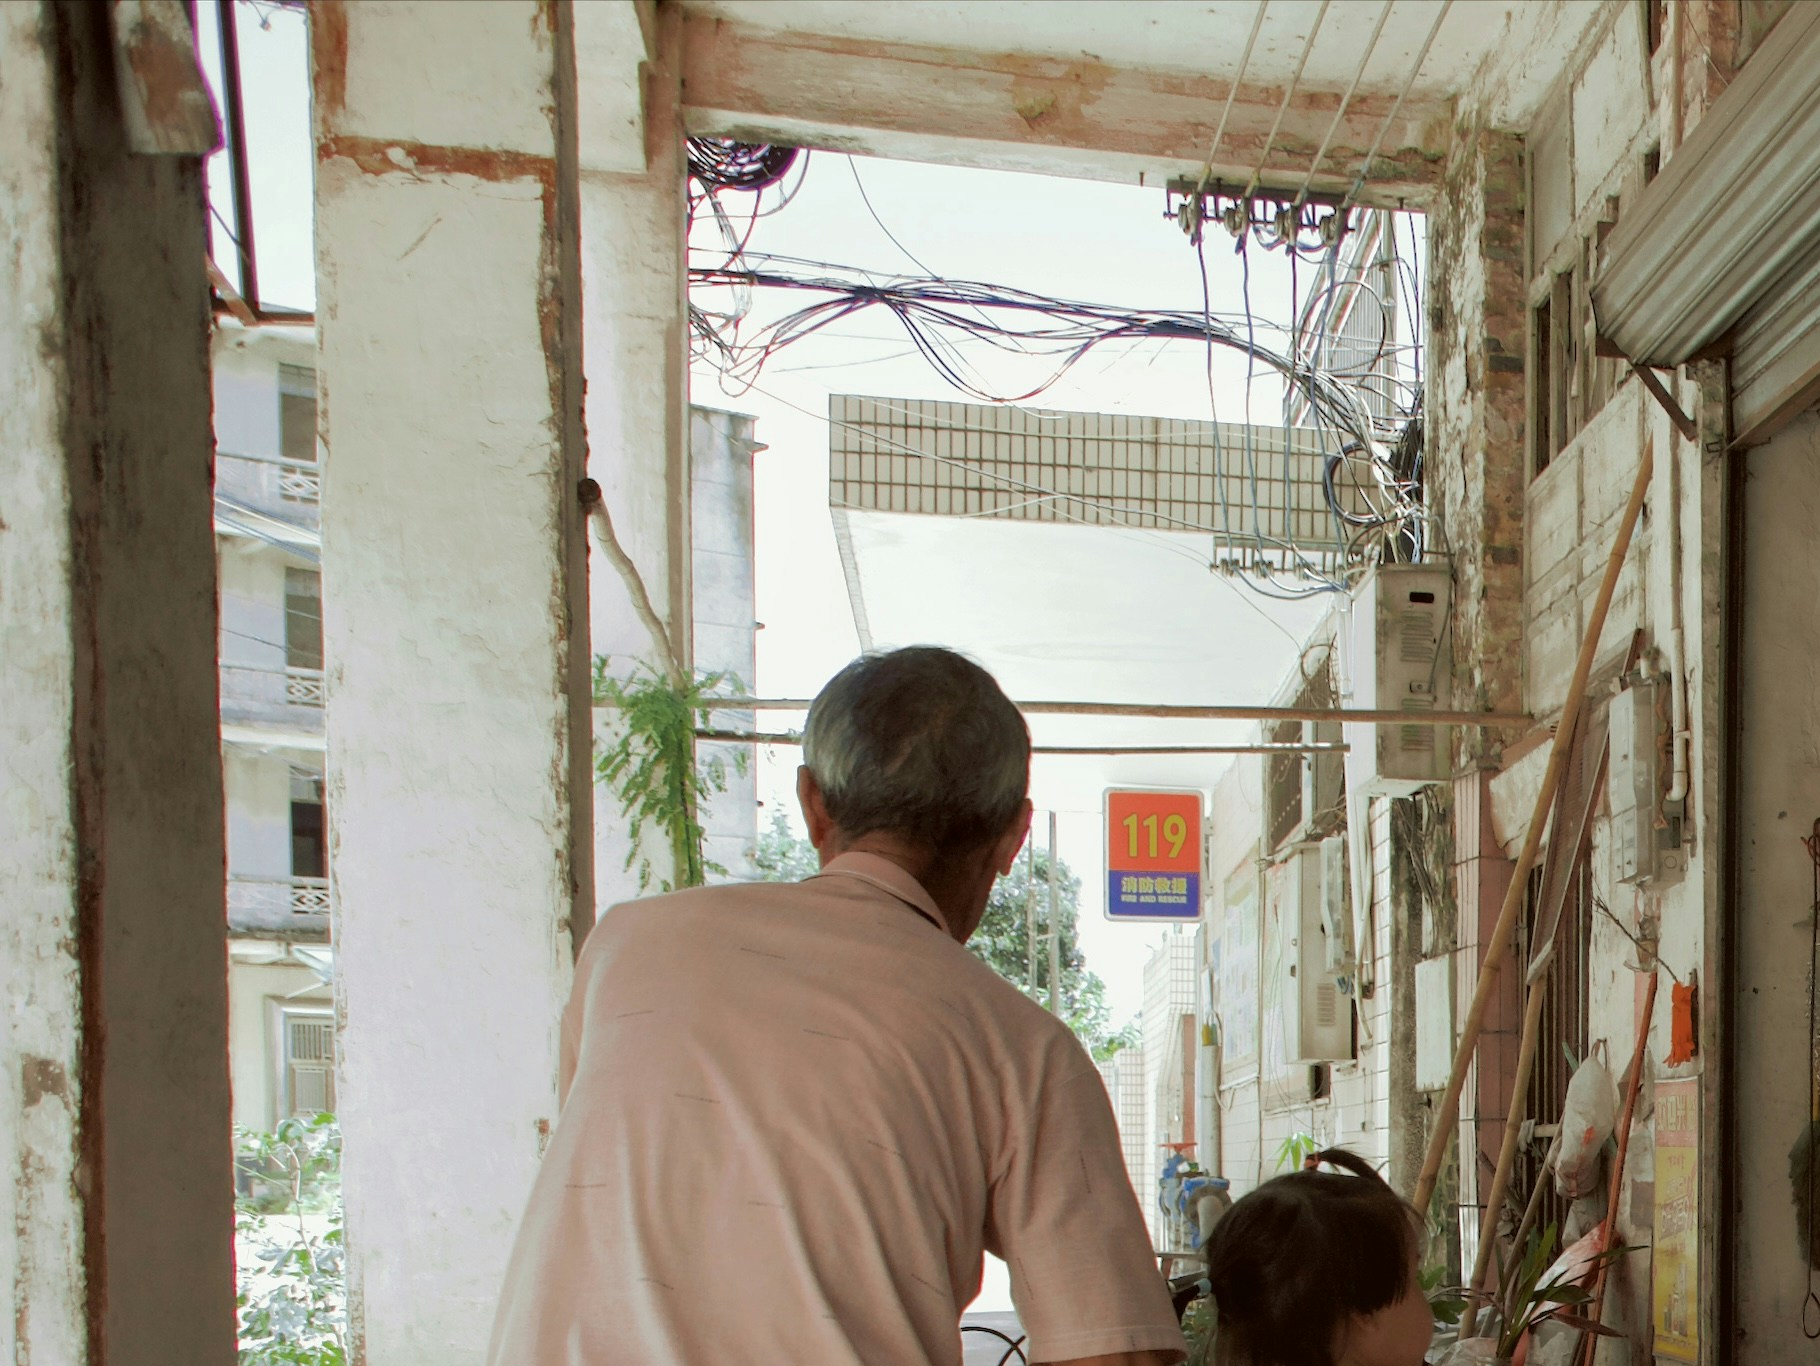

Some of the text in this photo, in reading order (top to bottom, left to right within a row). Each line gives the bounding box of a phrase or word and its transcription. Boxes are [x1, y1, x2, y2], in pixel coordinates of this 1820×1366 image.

[1122, 813, 1187, 858] 119
[1121, 876, 1187, 894] 消防救援
